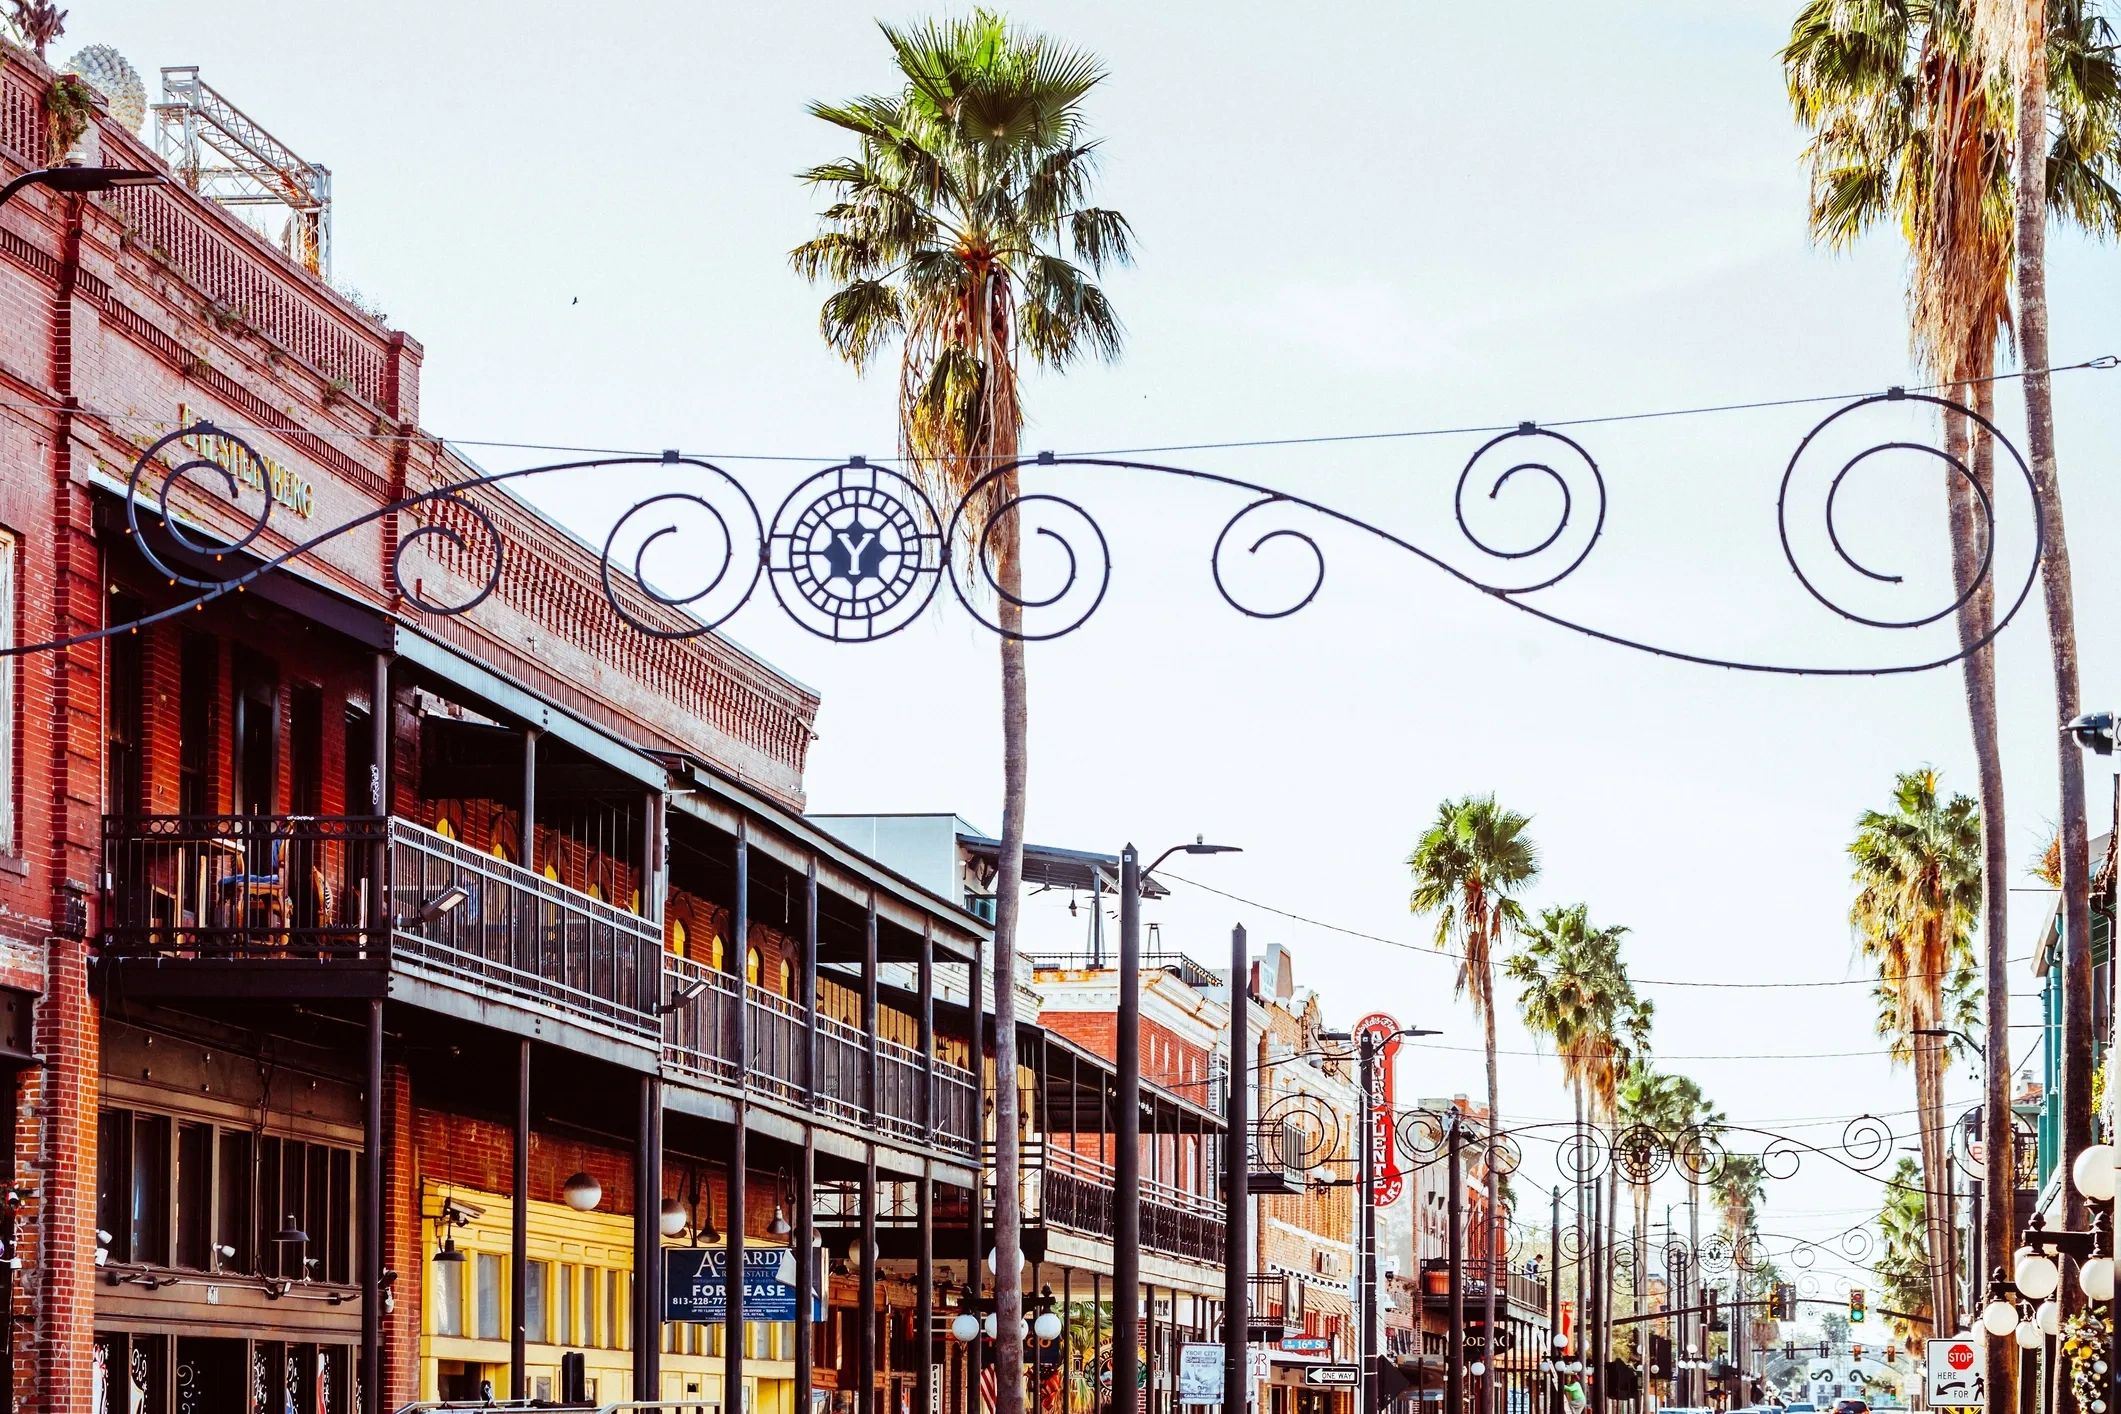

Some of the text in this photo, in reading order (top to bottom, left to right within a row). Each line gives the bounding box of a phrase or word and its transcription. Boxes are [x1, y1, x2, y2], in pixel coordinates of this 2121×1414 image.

[836, 523, 876, 566] Y
[1372, 1111, 1387, 1189] FUENTE
[692, 1250, 785, 1278] ACARDI
[692, 1285, 786, 1297] FOR EASE
[1315, 1340, 1325, 1349] St
[1462, 1335, 1506, 1347] ODAC
[1948, 1352, 1974, 1363] STOP
[1338, 1372, 1352, 1380] WAY
[1937, 1371, 1957, 1380] HERE
[1953, 1390, 1969, 1398] FOR
